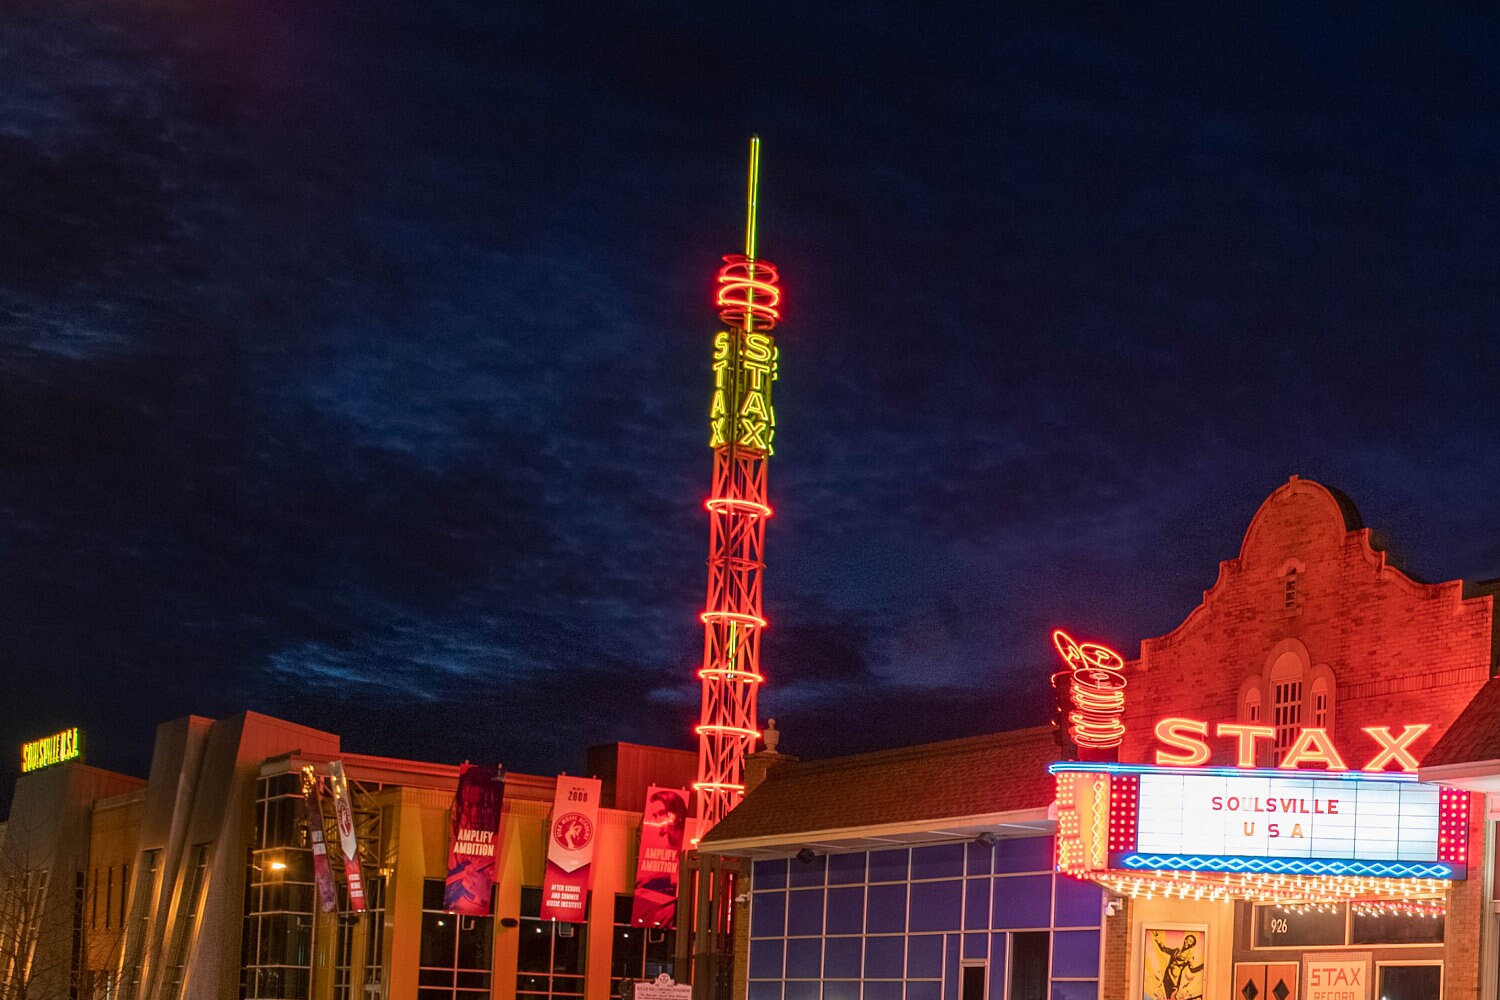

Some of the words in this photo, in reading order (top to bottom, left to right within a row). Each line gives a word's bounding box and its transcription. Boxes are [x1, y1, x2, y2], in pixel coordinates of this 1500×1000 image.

[709, 331, 728, 448] STAX
[741, 333, 771, 450] STAX
[1154, 717, 1432, 772] STAX
[568, 790, 588, 802] 2000
[1211, 796, 1340, 815] SOULSVILLE
[457, 829, 494, 844] AMPLIFY
[454, 841, 495, 857] AMBITION
[644, 847, 677, 862] AMPLIFY
[641, 859, 678, 873] AMBITION
[1271, 918, 1288, 934] 926
[1310, 968, 1361, 987] STAX
